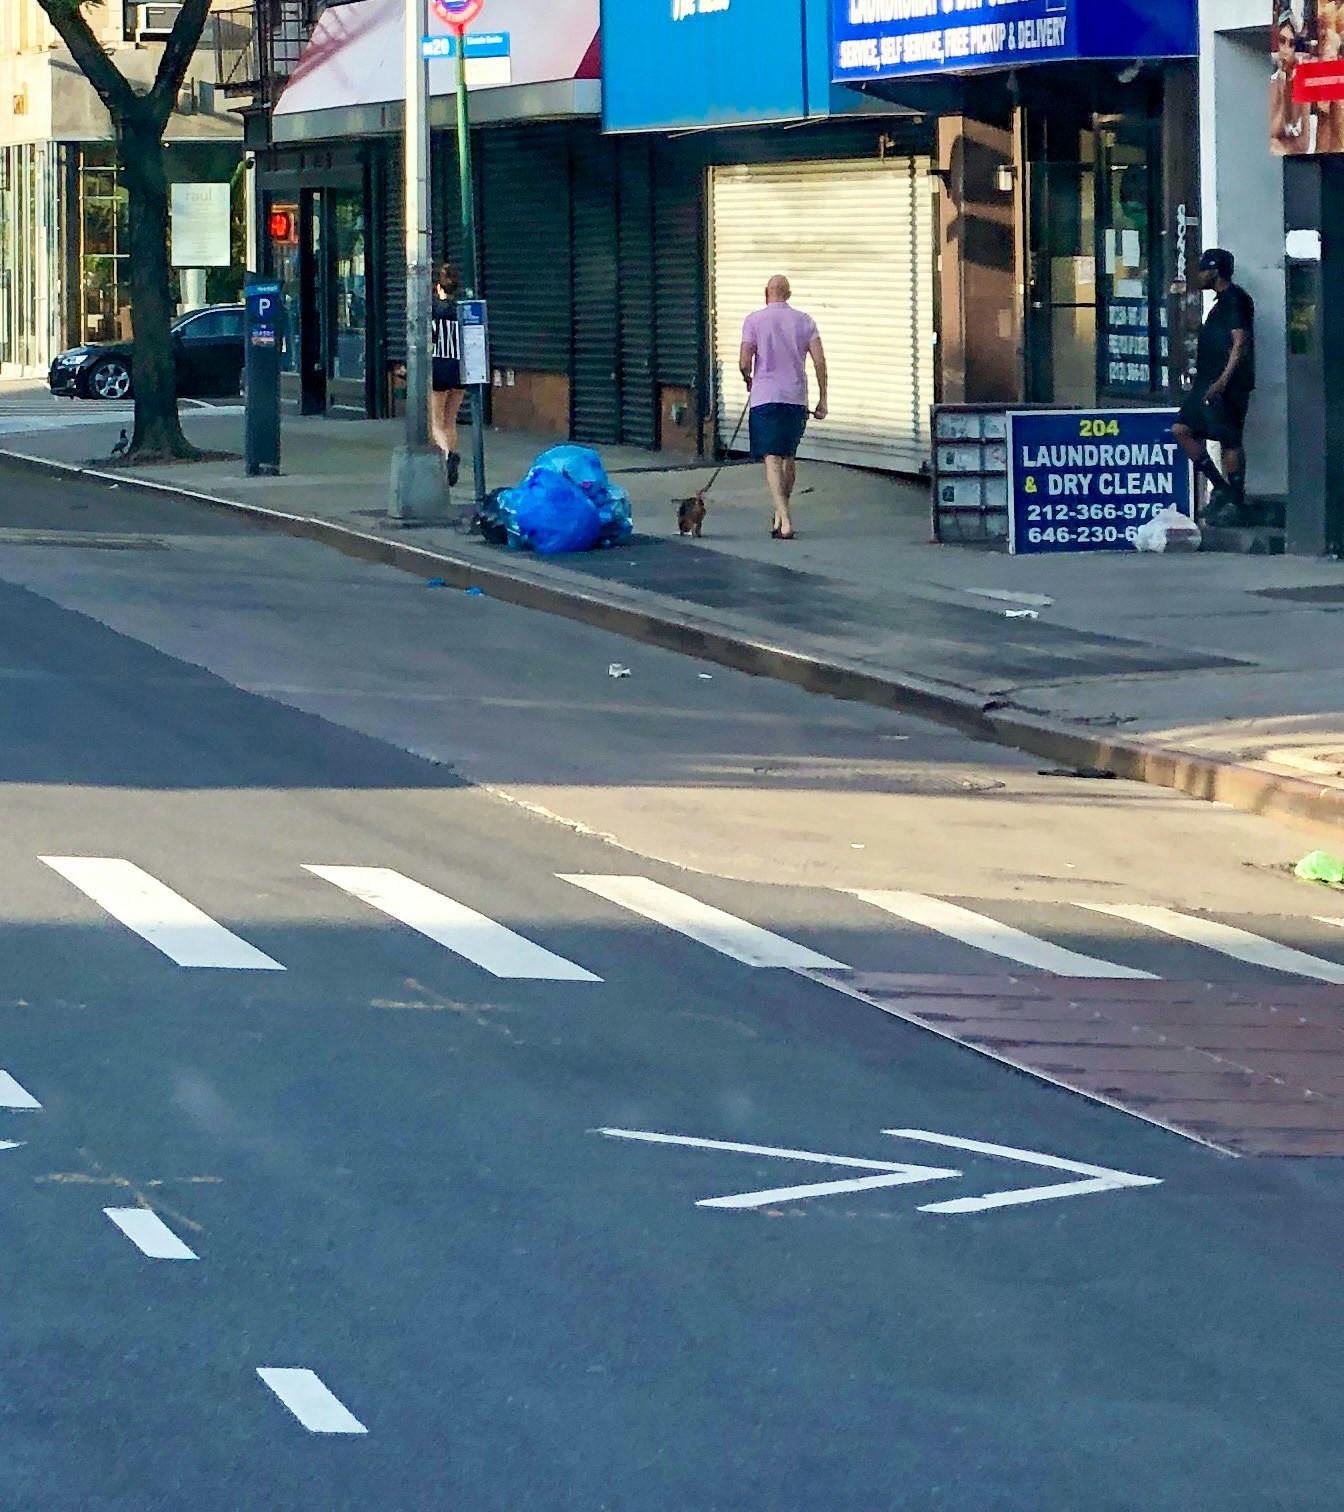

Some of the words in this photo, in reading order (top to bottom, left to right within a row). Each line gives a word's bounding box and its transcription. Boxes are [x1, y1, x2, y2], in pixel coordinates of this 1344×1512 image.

[945, 26, 970, 58] FREE
[970, 22, 1006, 54] PICKUP
[1008, 21, 1016, 51] &
[1018, 15, 1067, 50] DELIVERY
[259, 298, 271, 317] P
[1079, 419, 1120, 437] 204
[1022, 443, 1178, 468] LAUNDROMAT
[1024, 475, 1038, 494] &
[1048, 473, 1093, 496] DRY
[1098, 471, 1173, 495] CLEAN
